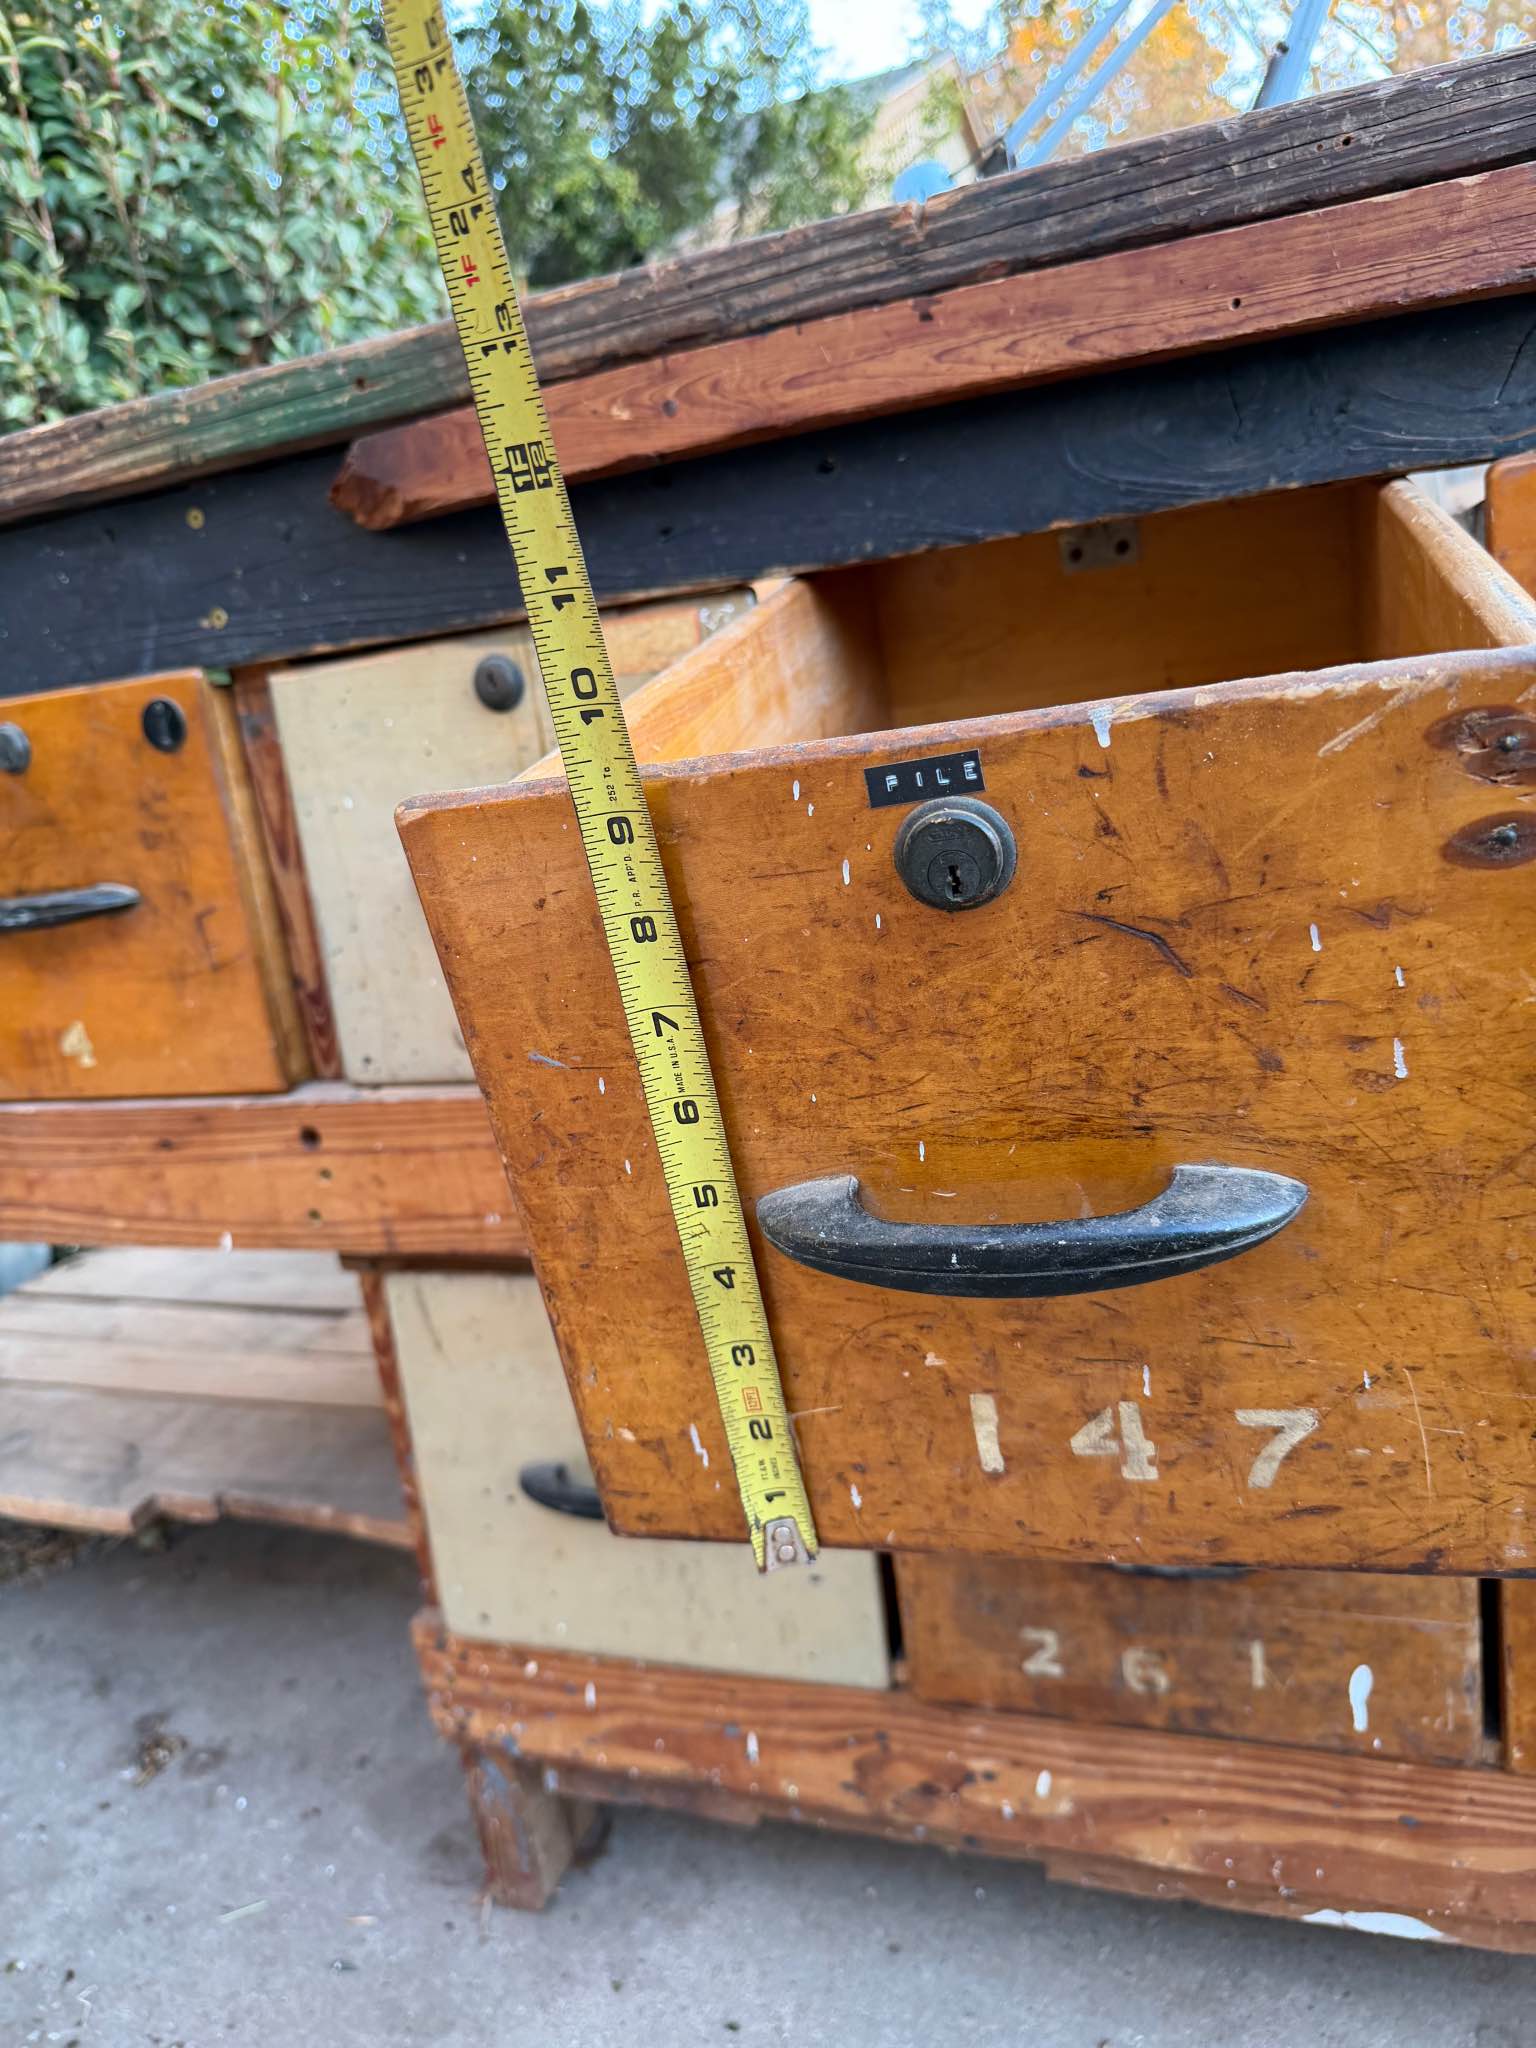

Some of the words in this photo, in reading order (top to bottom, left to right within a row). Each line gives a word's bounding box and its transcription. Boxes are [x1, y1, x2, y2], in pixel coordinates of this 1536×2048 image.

[544, 566, 576, 612] 11
[570, 667, 605, 726] 10
[885, 760, 978, 792] FILE
[606, 784, 617, 802] 252
[606, 816, 635, 845] 9
[630, 915, 658, 944] 8
[651, 1011, 680, 1038] 7
[666, 1035, 679, 1058] U.S.A.
[671, 1060, 680, 1069] IN
[674, 1072, 685, 1093] MADE
[673, 1099, 700, 1125] 6
[692, 1184, 719, 1209] 5
[713, 1265, 736, 1290] 4
[731, 1343, 756, 1367] 3
[748, 1419, 773, 1440] 2
[765, 1490, 786, 1503] 1
